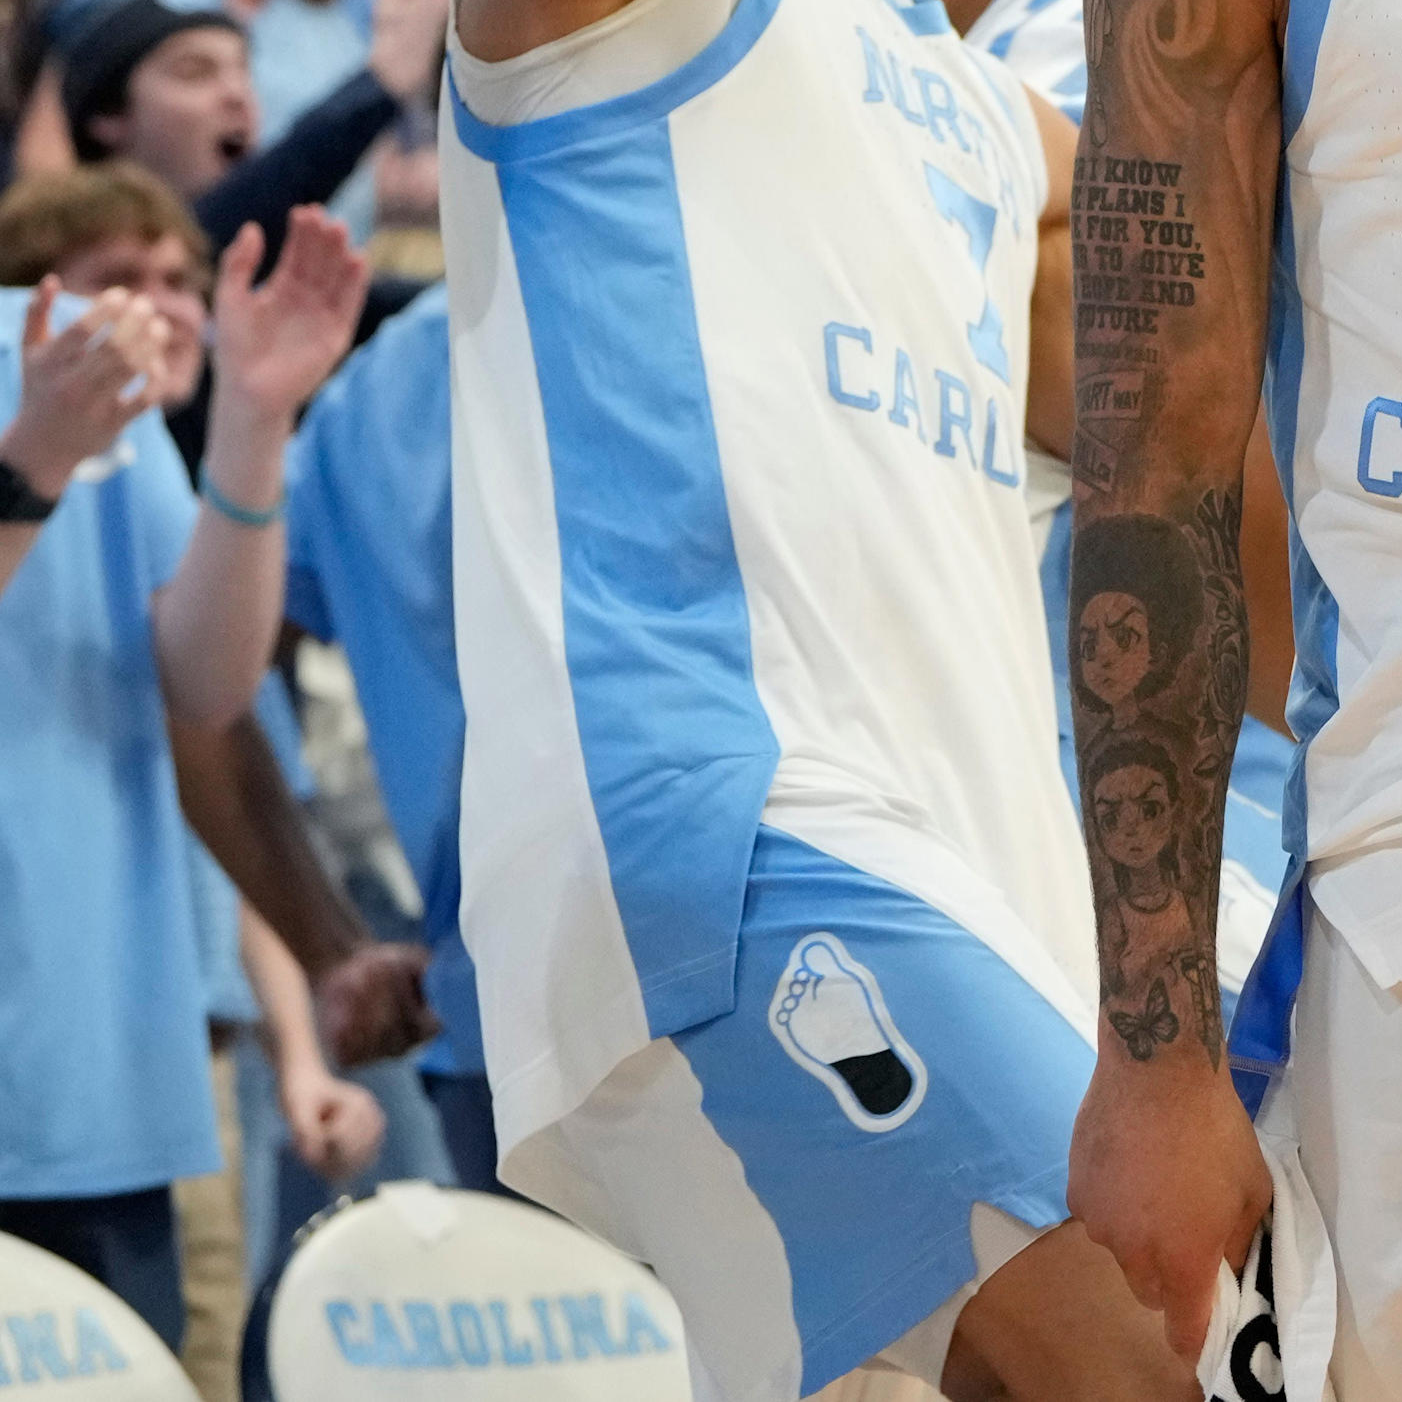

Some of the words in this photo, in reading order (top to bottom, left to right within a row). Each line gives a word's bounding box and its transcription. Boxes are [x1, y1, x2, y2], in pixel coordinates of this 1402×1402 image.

[1104, 156, 1182, 187] KNOW
[1087, 186, 1165, 216] PLANS
[1175, 193, 1185, 217] I
[1087, 215, 1129, 242] FOR
[1140, 278, 1195, 307] AND
[325, 1292, 673, 1368] CAROLINA
